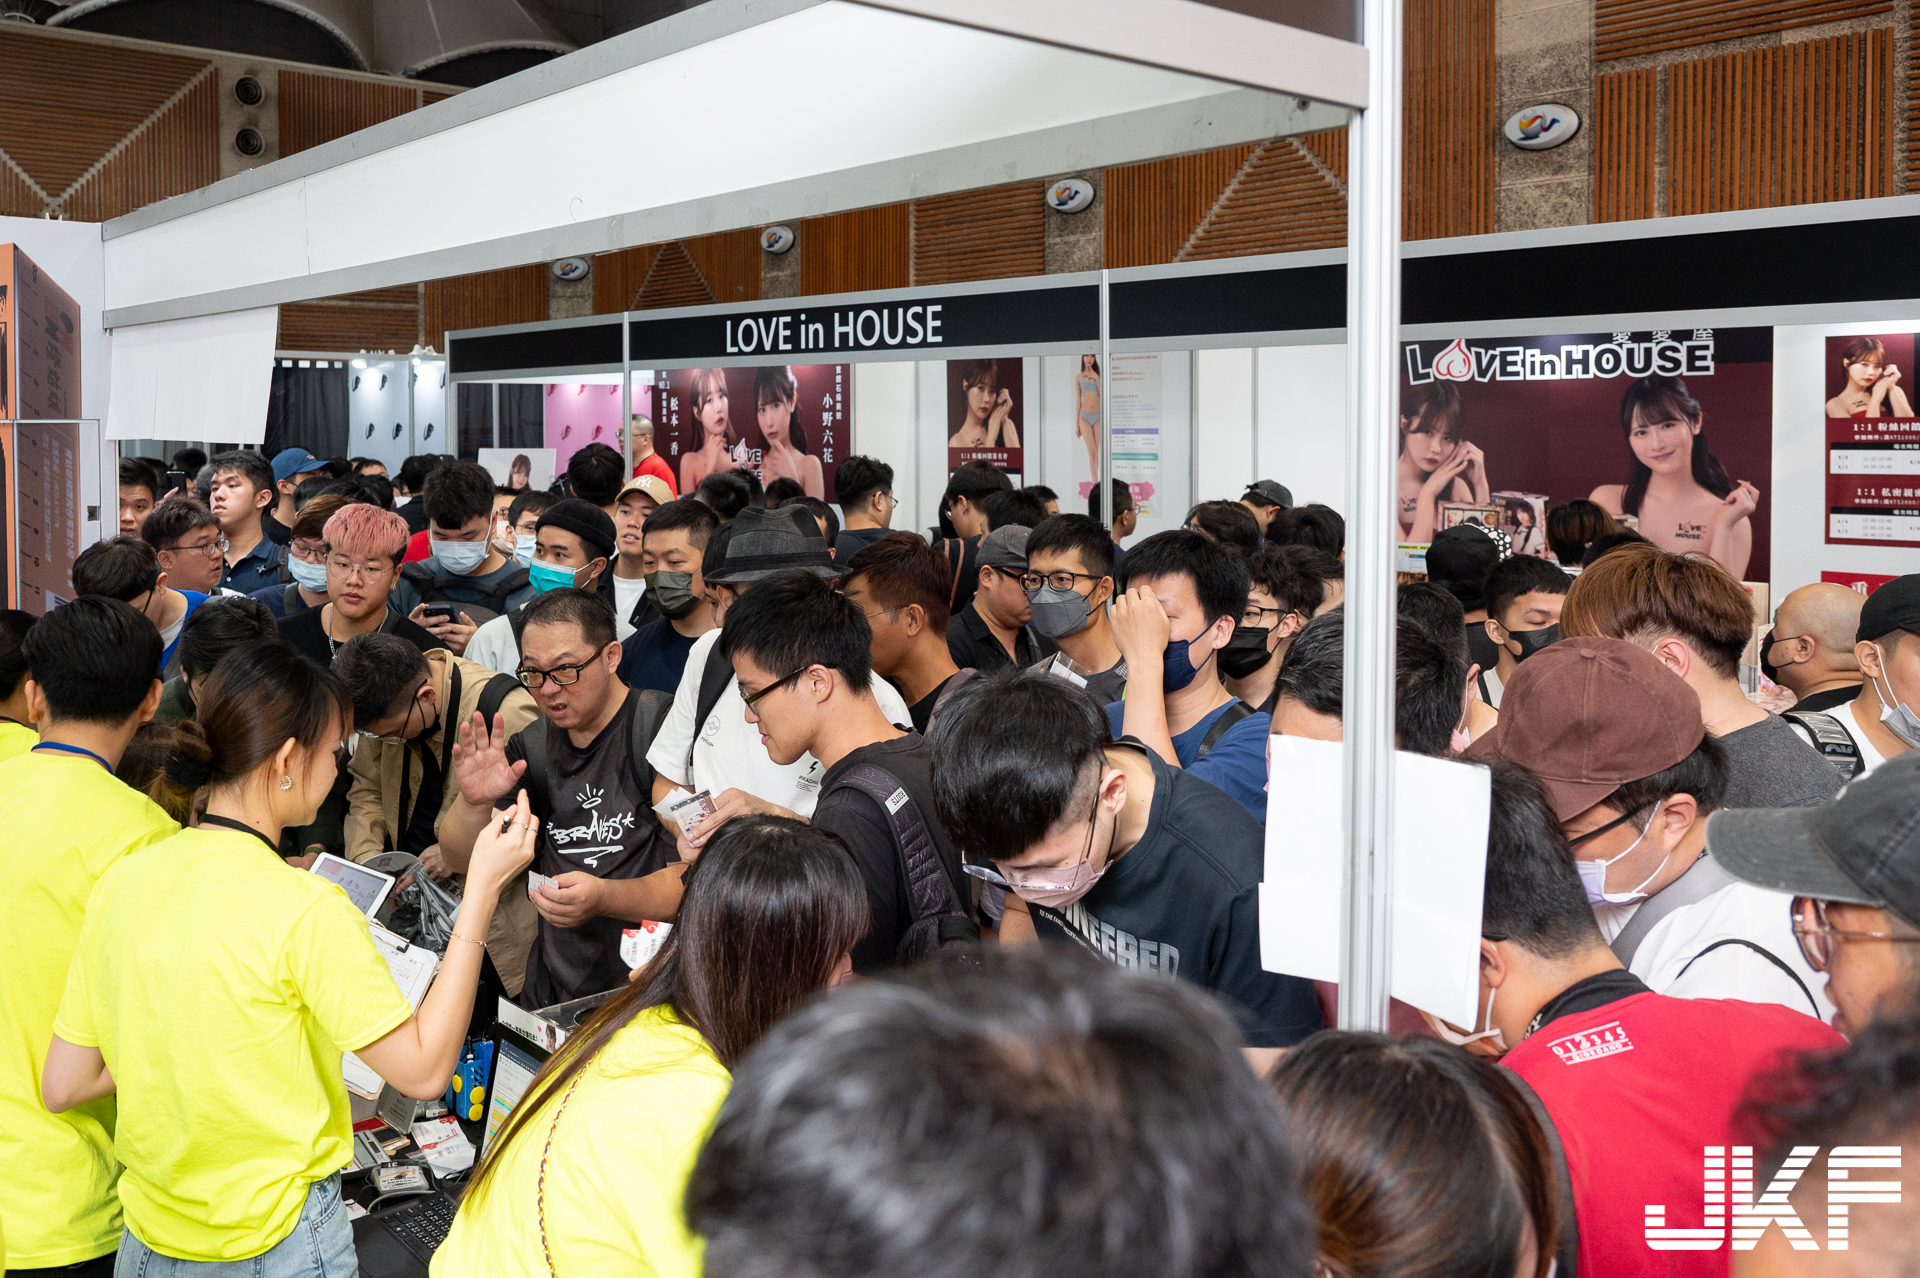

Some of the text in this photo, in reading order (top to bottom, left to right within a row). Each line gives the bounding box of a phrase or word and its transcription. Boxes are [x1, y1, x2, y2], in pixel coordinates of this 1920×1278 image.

[726, 305, 943, 353] LOVE in HOUSE
[670, 396, 679, 456] 松本一香
[822, 393, 834, 463] 小野六花
[1853, 423, 1872, 431] 1:1
[635, 476, 653, 488] NY
[1856, 488, 1875, 496] 1:1
[1571, 1042, 1623, 1060] GIORDANO
